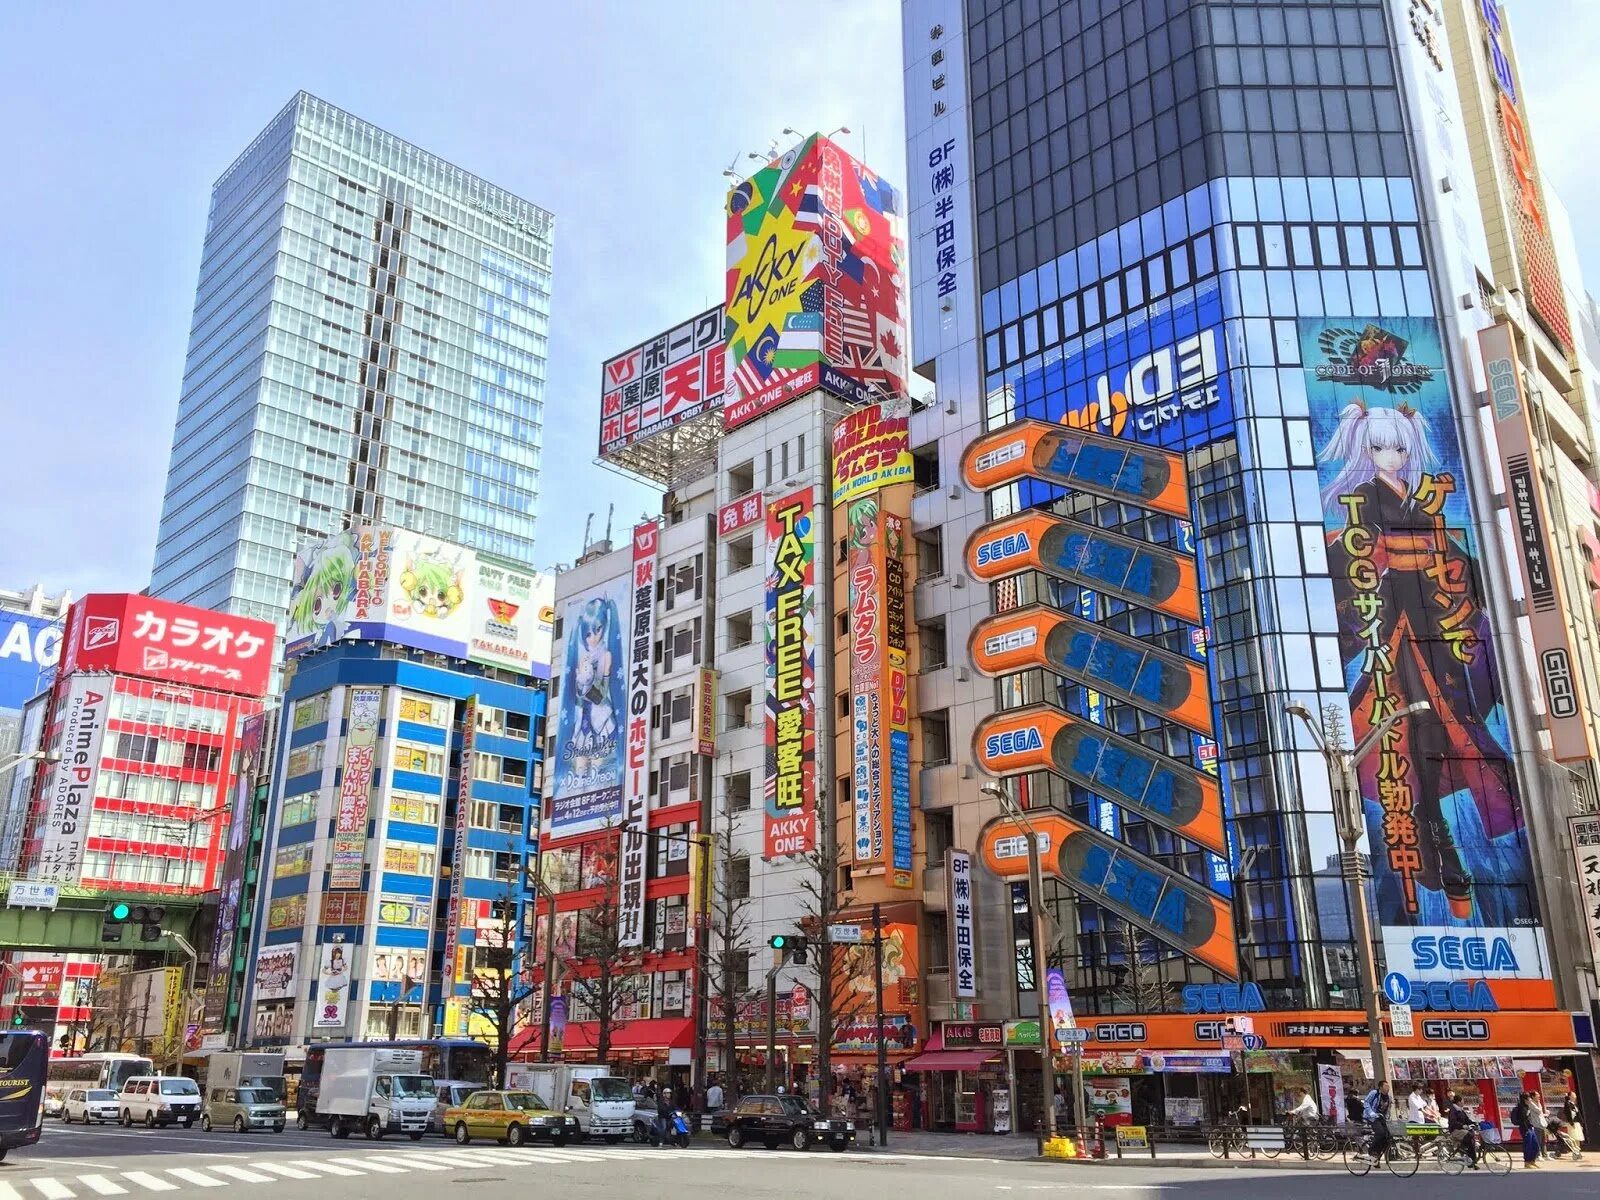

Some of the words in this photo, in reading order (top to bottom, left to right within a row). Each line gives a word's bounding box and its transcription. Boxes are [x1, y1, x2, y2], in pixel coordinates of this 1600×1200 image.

[1316, 364, 1355, 376] CODE
[1358, 364, 1377, 376] OF
[1487, 358, 1521, 424] SEGA
[853, 472, 878, 489] WORLD
[881, 466, 911, 479] AKIBA
[722, 499, 759, 531] 免税
[776, 503, 803, 589] TAX
[977, 532, 1031, 567] SEGA
[356, 532, 373, 619] AKIHABARA
[889, 573, 901, 584] CD
[852, 565, 877, 665] ラムタラ
[133, 610, 265, 659] カラオケ
[472, 638, 529, 662] TAKARADA
[776, 591, 803, 702] FREE
[67, 697, 82, 752] Produced
[986, 727, 1043, 759] SEGA
[63, 757, 74, 772] by
[776, 709, 803, 809] 愛客旺
[457, 765, 468, 830] TAKARADA
[769, 818, 809, 838] AKKY
[774, 835, 806, 854] ONE
[14, 885, 56, 896] 万世橋
[834, 927, 860, 936] 万世橋
[1411, 935, 1520, 971] SEGA
[1182, 982, 1268, 1014] SEGA
[1411, 980, 1499, 1011] SEGA
[1096, 1022, 1147, 1042] GiGO
[1244, 1036, 1255, 1047] 17
[1287, 1025, 1345, 1034] アキハバラ
[1423, 1018, 1491, 1041] GiGO
